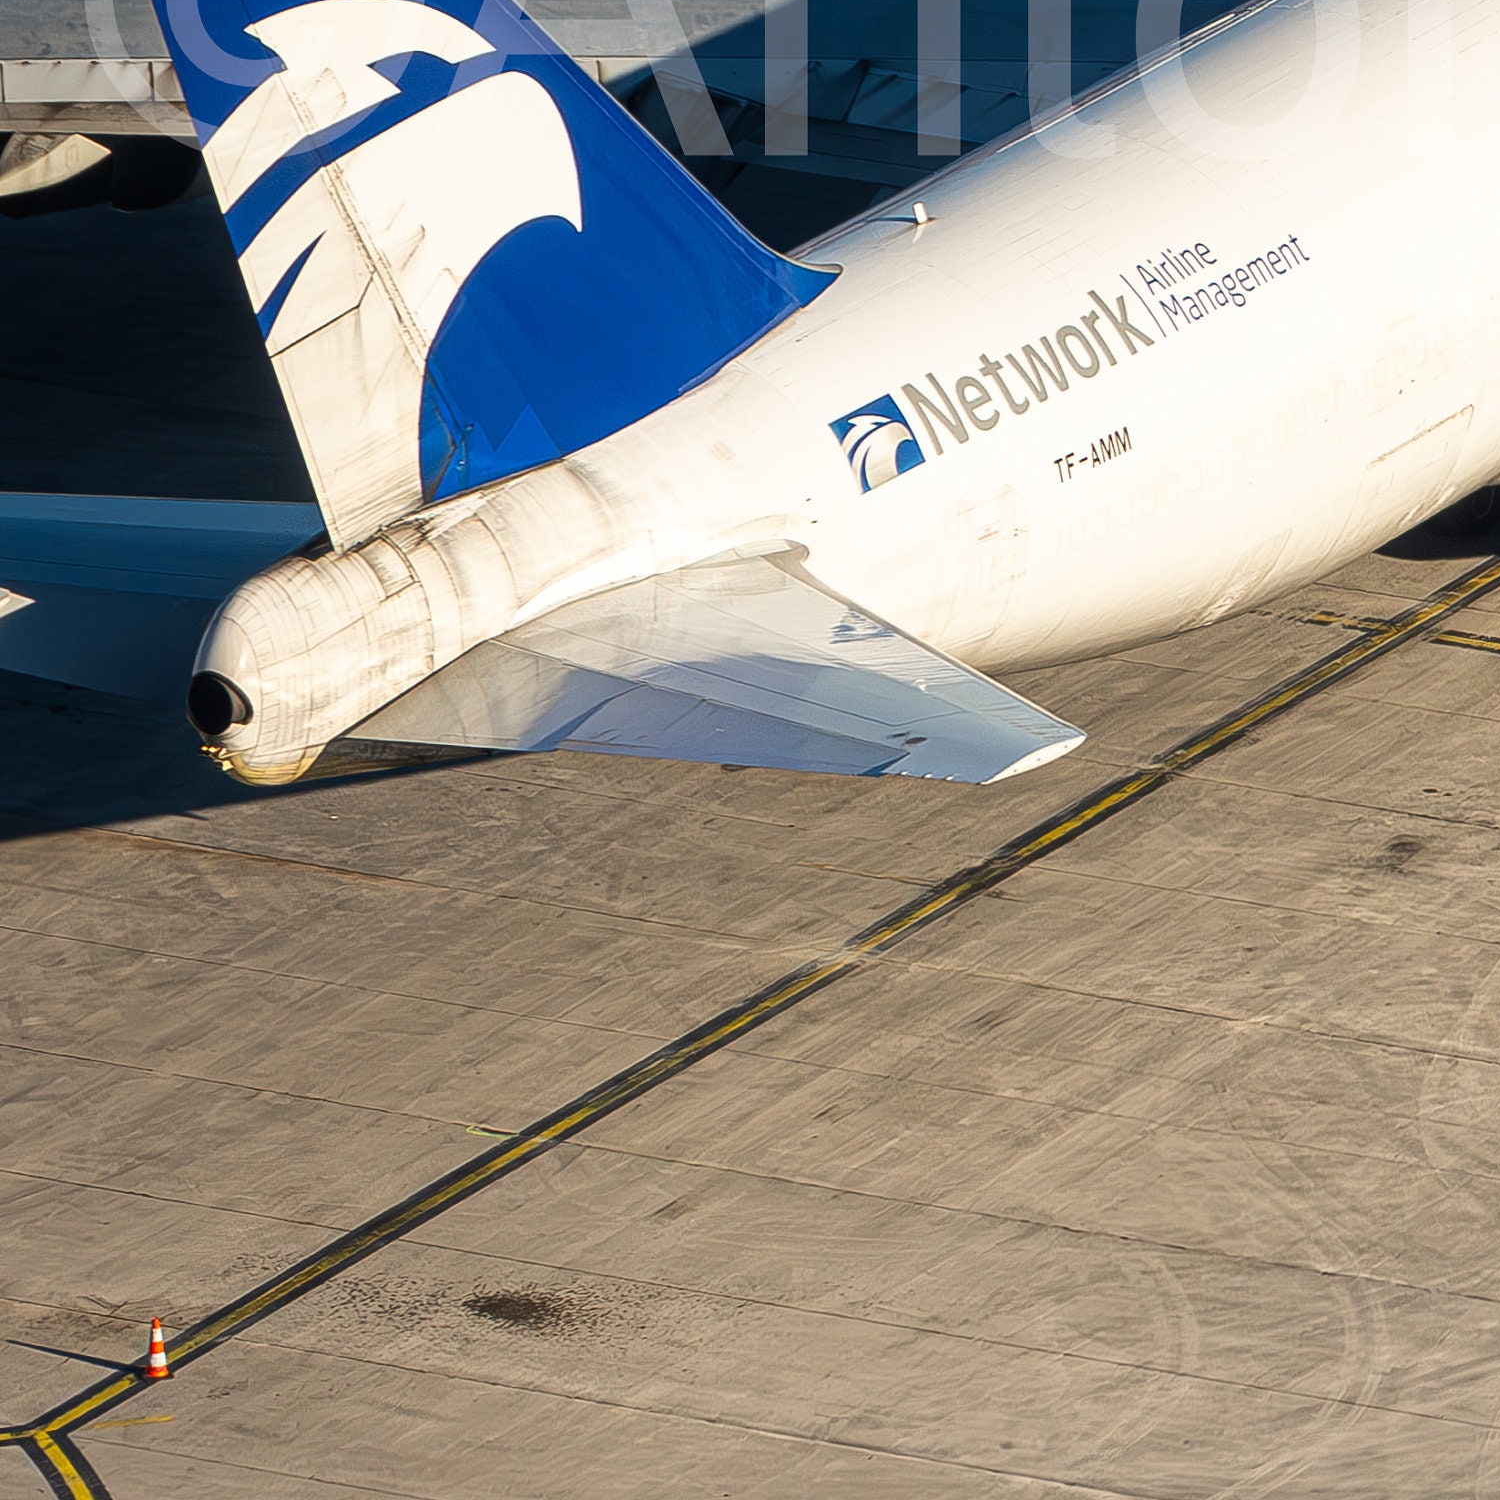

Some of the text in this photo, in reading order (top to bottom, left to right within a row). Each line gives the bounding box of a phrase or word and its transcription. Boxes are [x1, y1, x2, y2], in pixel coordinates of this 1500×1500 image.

[1136, 239, 1218, 296] Airline
[1159, 233, 1311, 332] Management
[901, 289, 1156, 456] Network
[1054, 427, 1132, 484] TF-AMM
